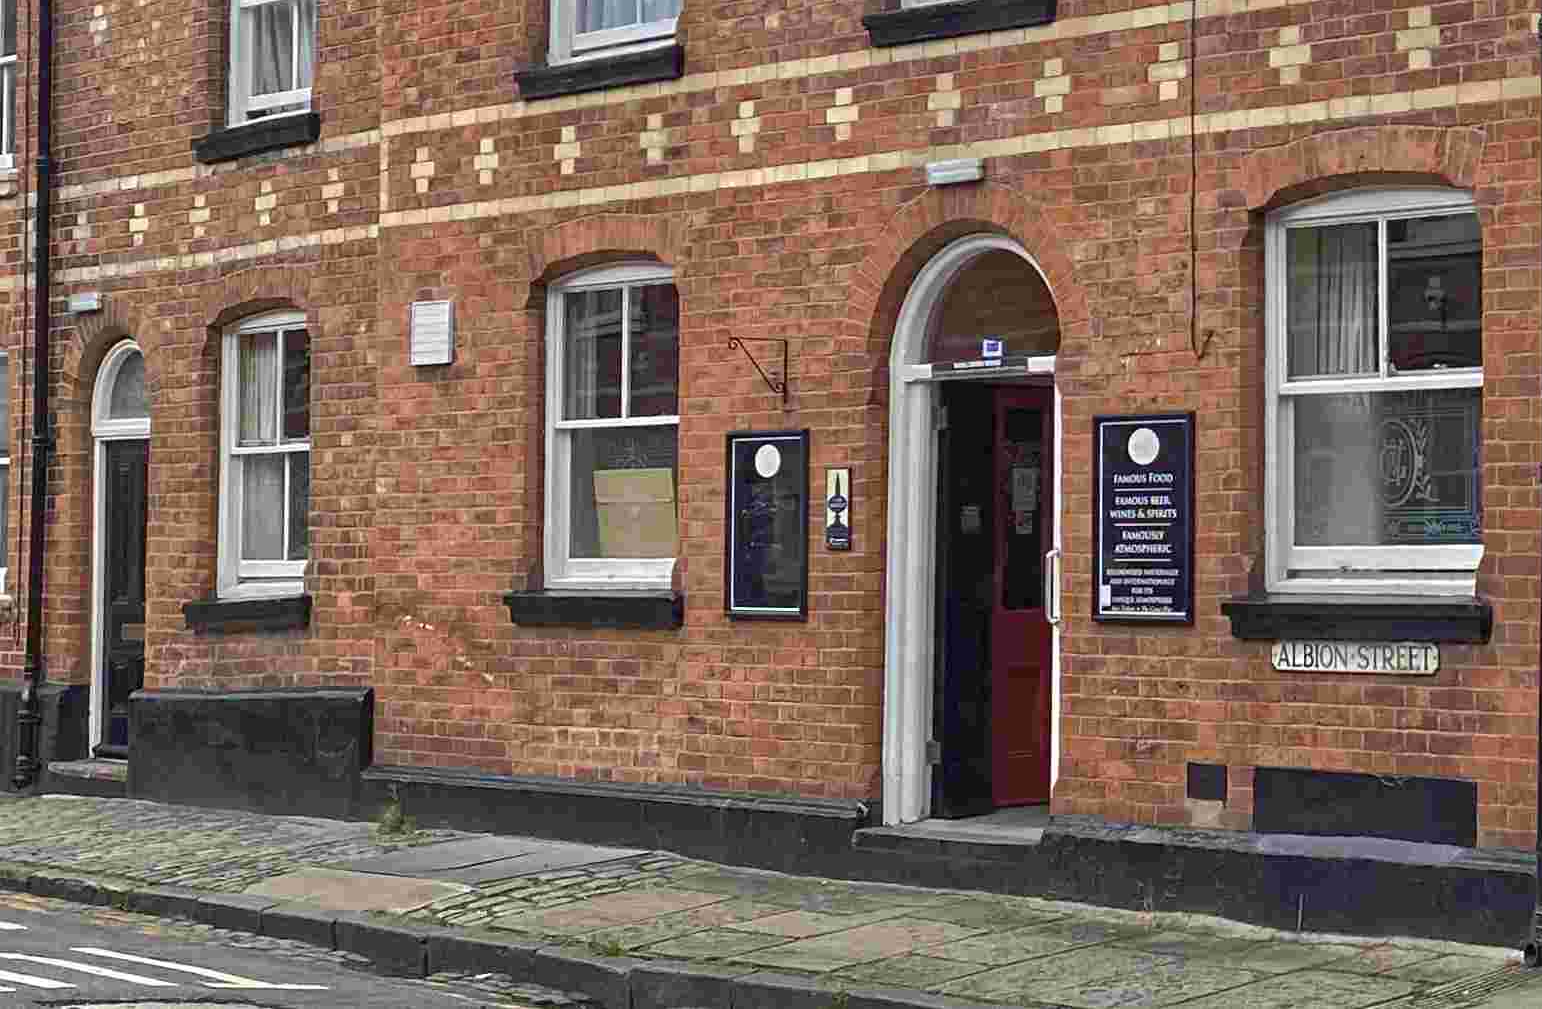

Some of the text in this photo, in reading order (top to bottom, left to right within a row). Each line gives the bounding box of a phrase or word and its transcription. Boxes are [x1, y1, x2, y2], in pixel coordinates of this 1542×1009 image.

[1113, 472, 1174, 484] FAMOUS FOOD
[1276, 642, 1433, 671] ALBION STREET
